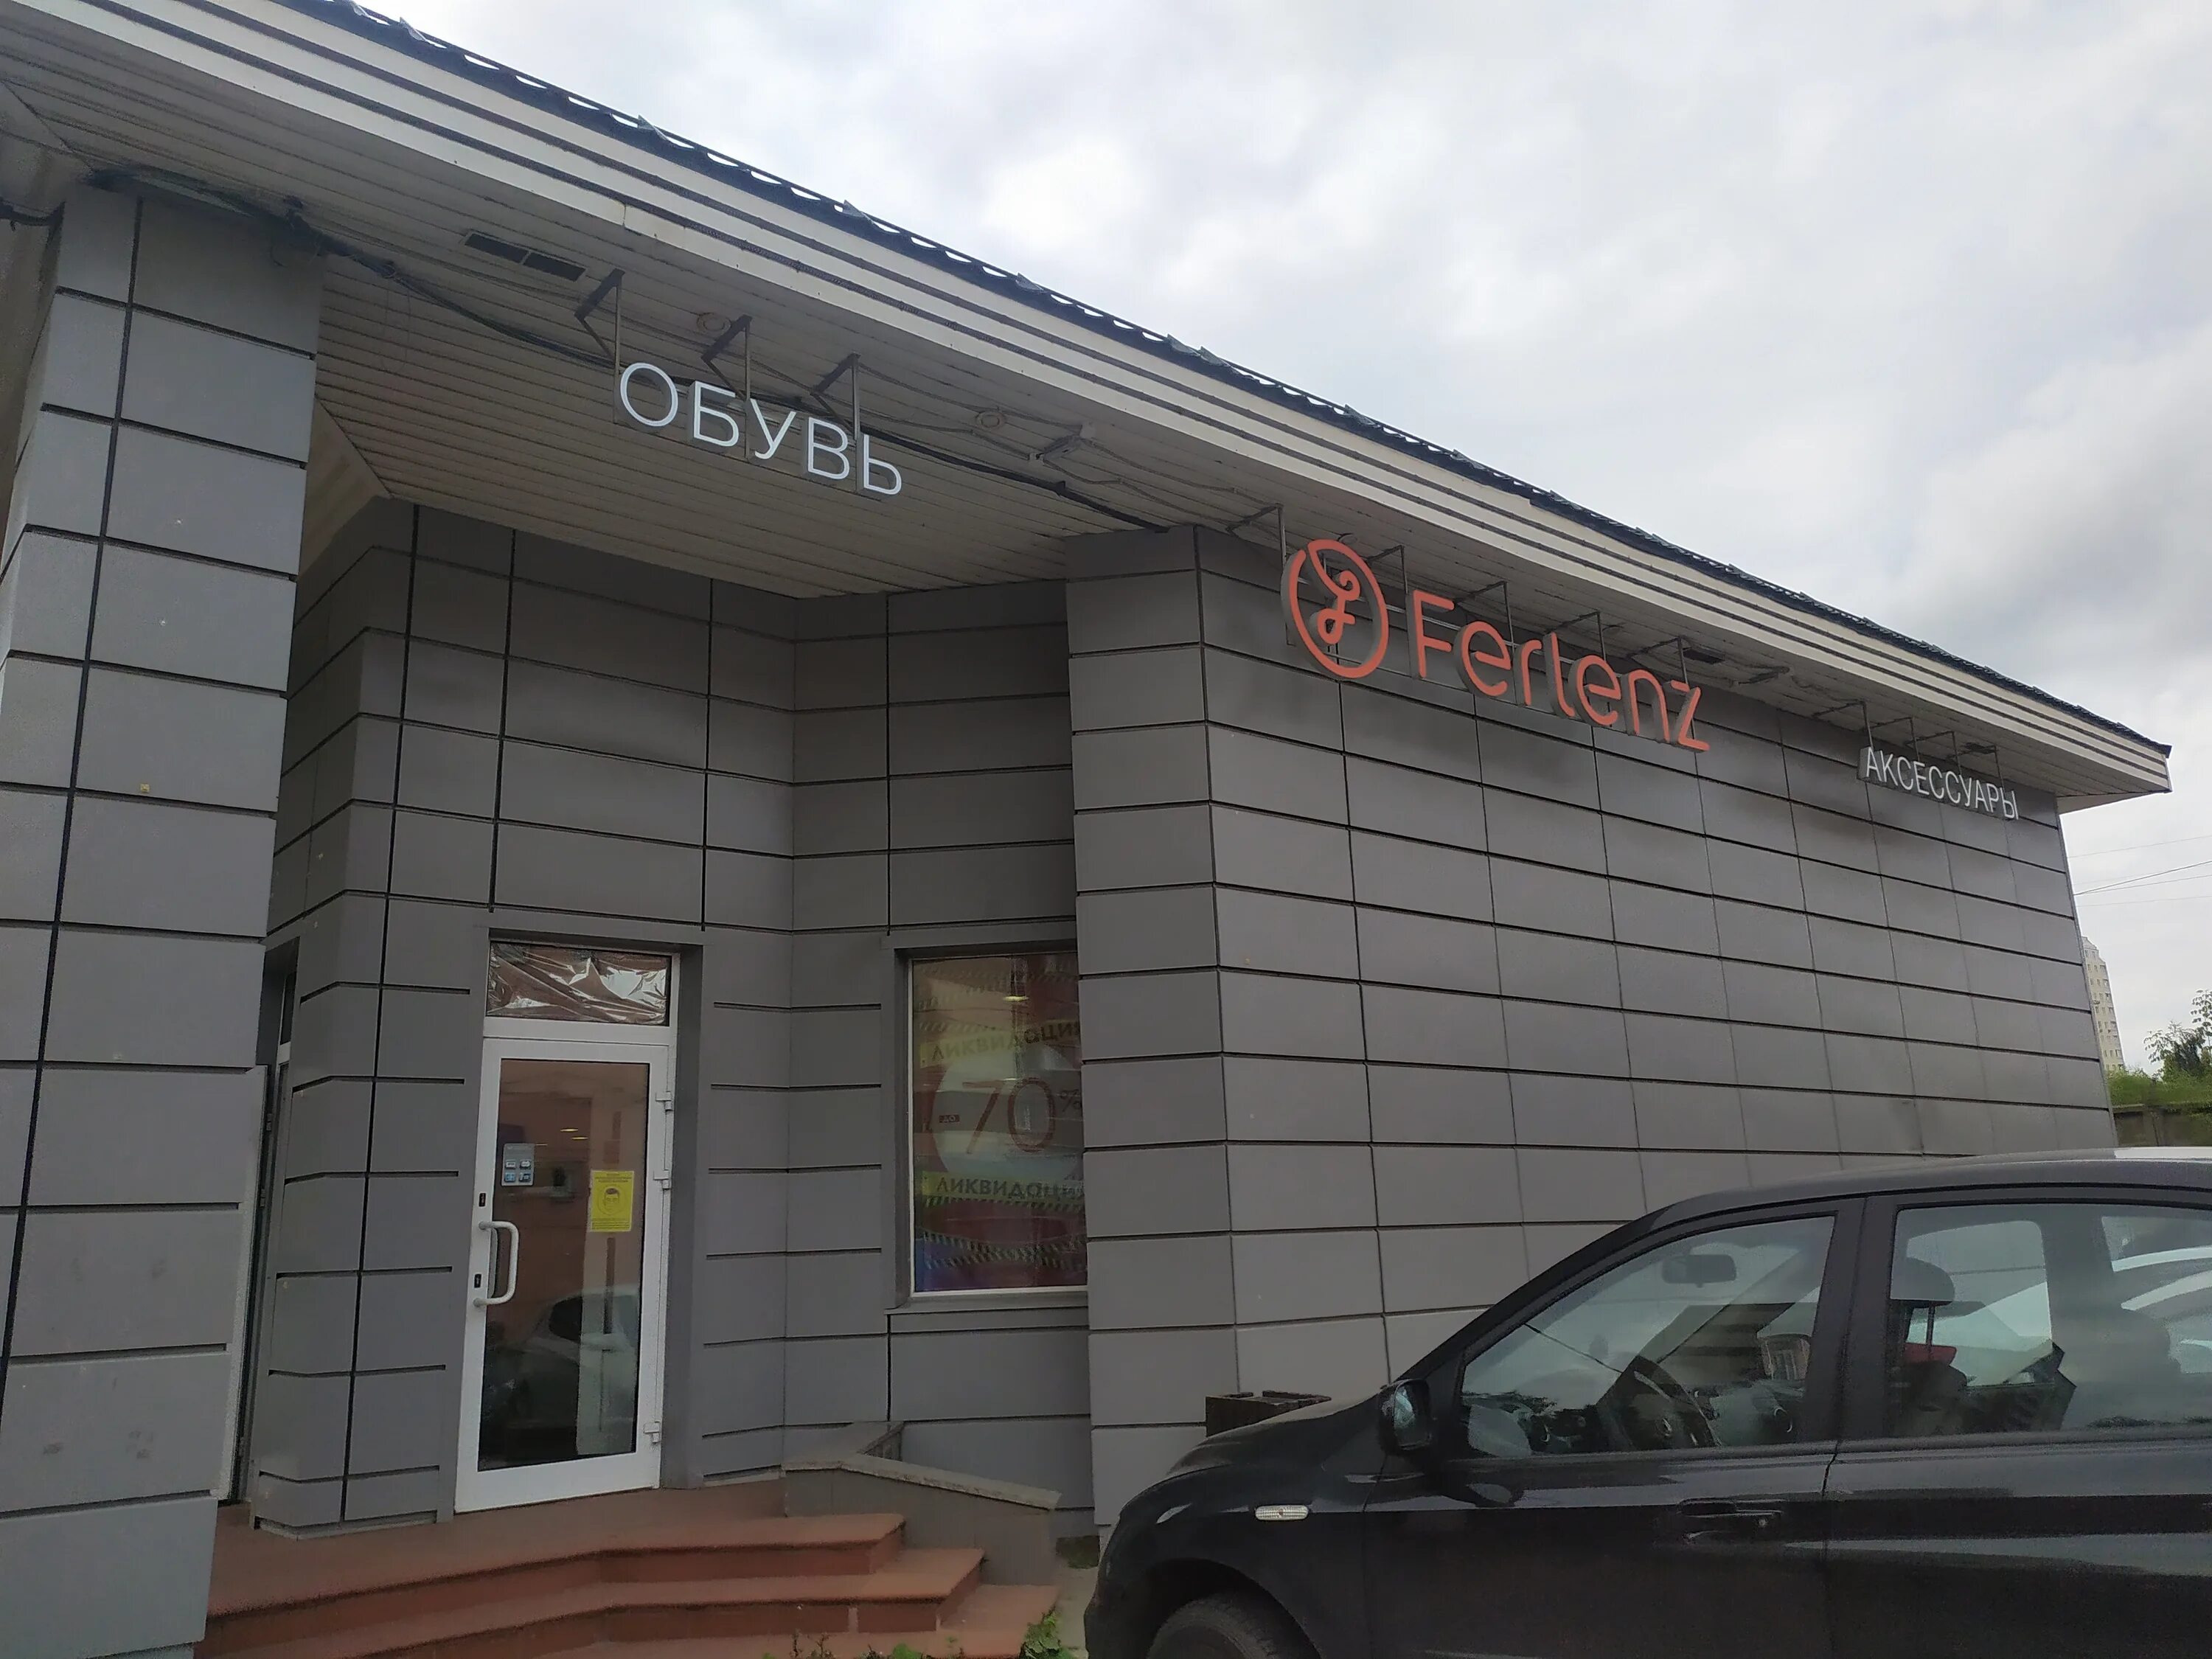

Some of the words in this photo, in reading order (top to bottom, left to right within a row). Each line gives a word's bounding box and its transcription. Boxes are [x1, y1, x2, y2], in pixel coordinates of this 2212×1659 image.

[619, 362, 902, 495] ОБУВЬ
[1410, 590, 1710, 752] Ferlenz
[1865, 746, 2019, 819] АКСЕССУАРЫ
